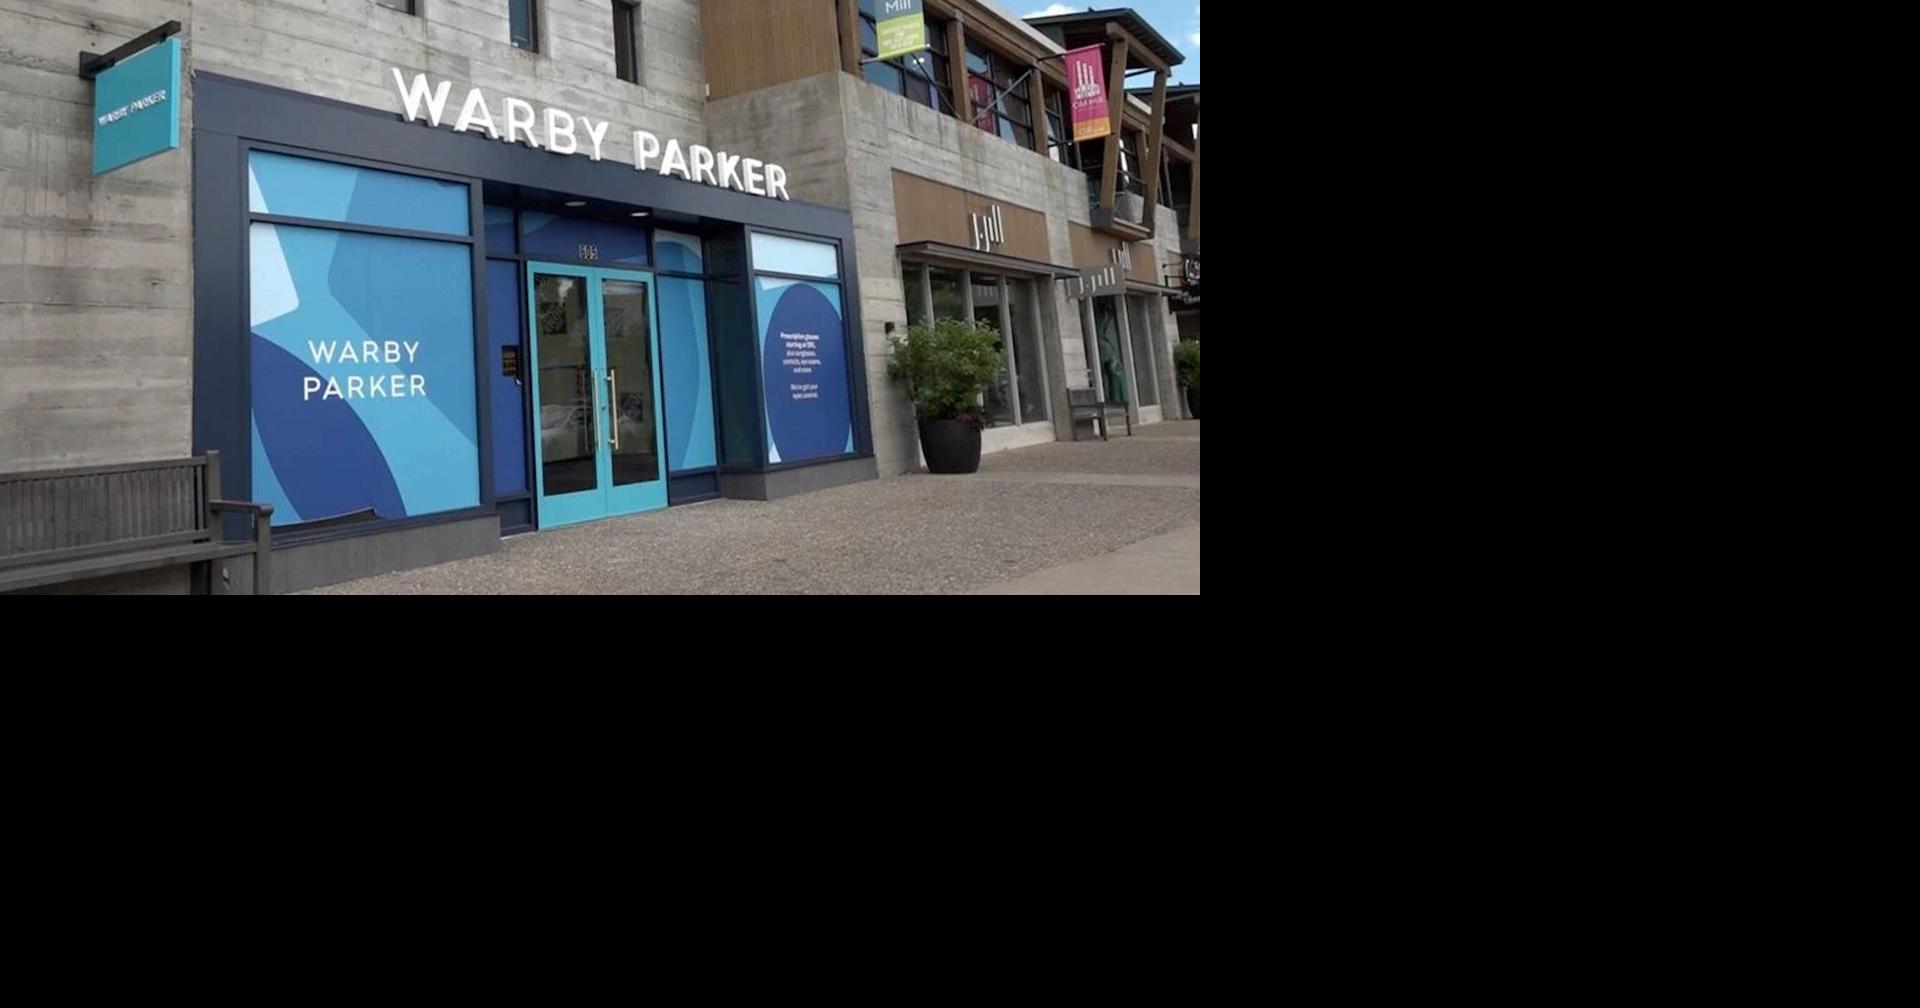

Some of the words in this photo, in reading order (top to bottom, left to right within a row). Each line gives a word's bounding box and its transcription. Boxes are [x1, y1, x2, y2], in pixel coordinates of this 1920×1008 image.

[130, 89, 166, 113] PARKER
[392, 67, 609, 161] WARBY
[633, 131, 790, 200] PARKER
[308, 340, 419, 364] WARBY
[304, 374, 426, 401] PARKER
